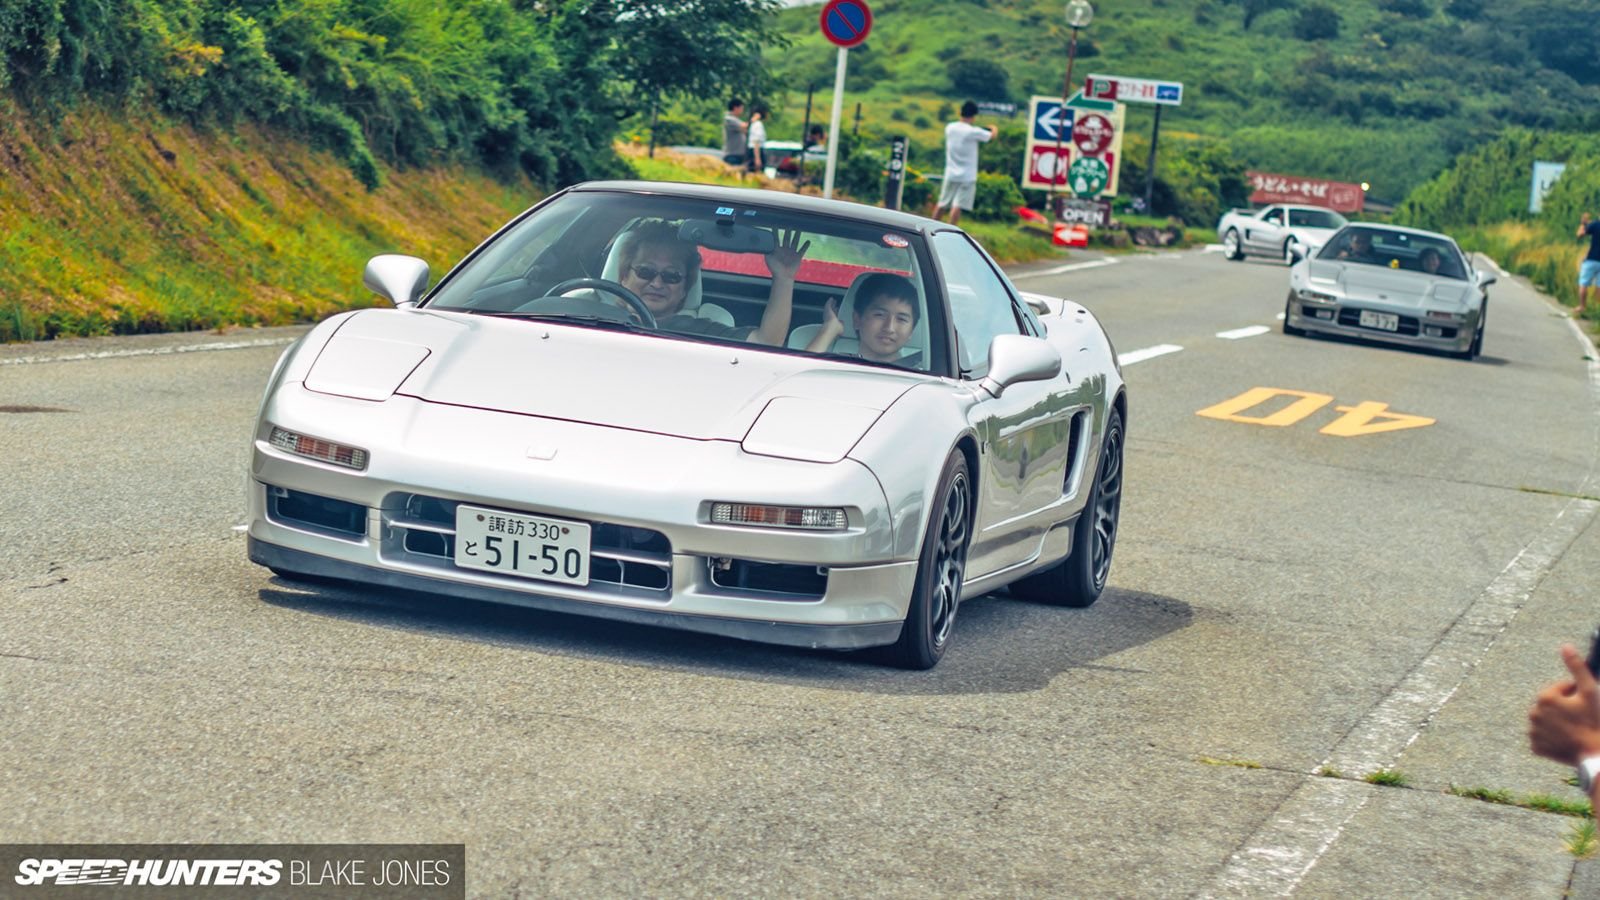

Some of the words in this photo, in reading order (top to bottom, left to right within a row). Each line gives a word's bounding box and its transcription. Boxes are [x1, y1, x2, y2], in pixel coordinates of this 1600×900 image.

[1062, 207, 1105, 225] OPEN
[1195, 386, 1437, 437] 40
[488, 516, 525, 537] 諏訪
[527, 521, 560, 541] 330
[465, 540, 478, 556] と
[485, 535, 581, 579] 51-50
